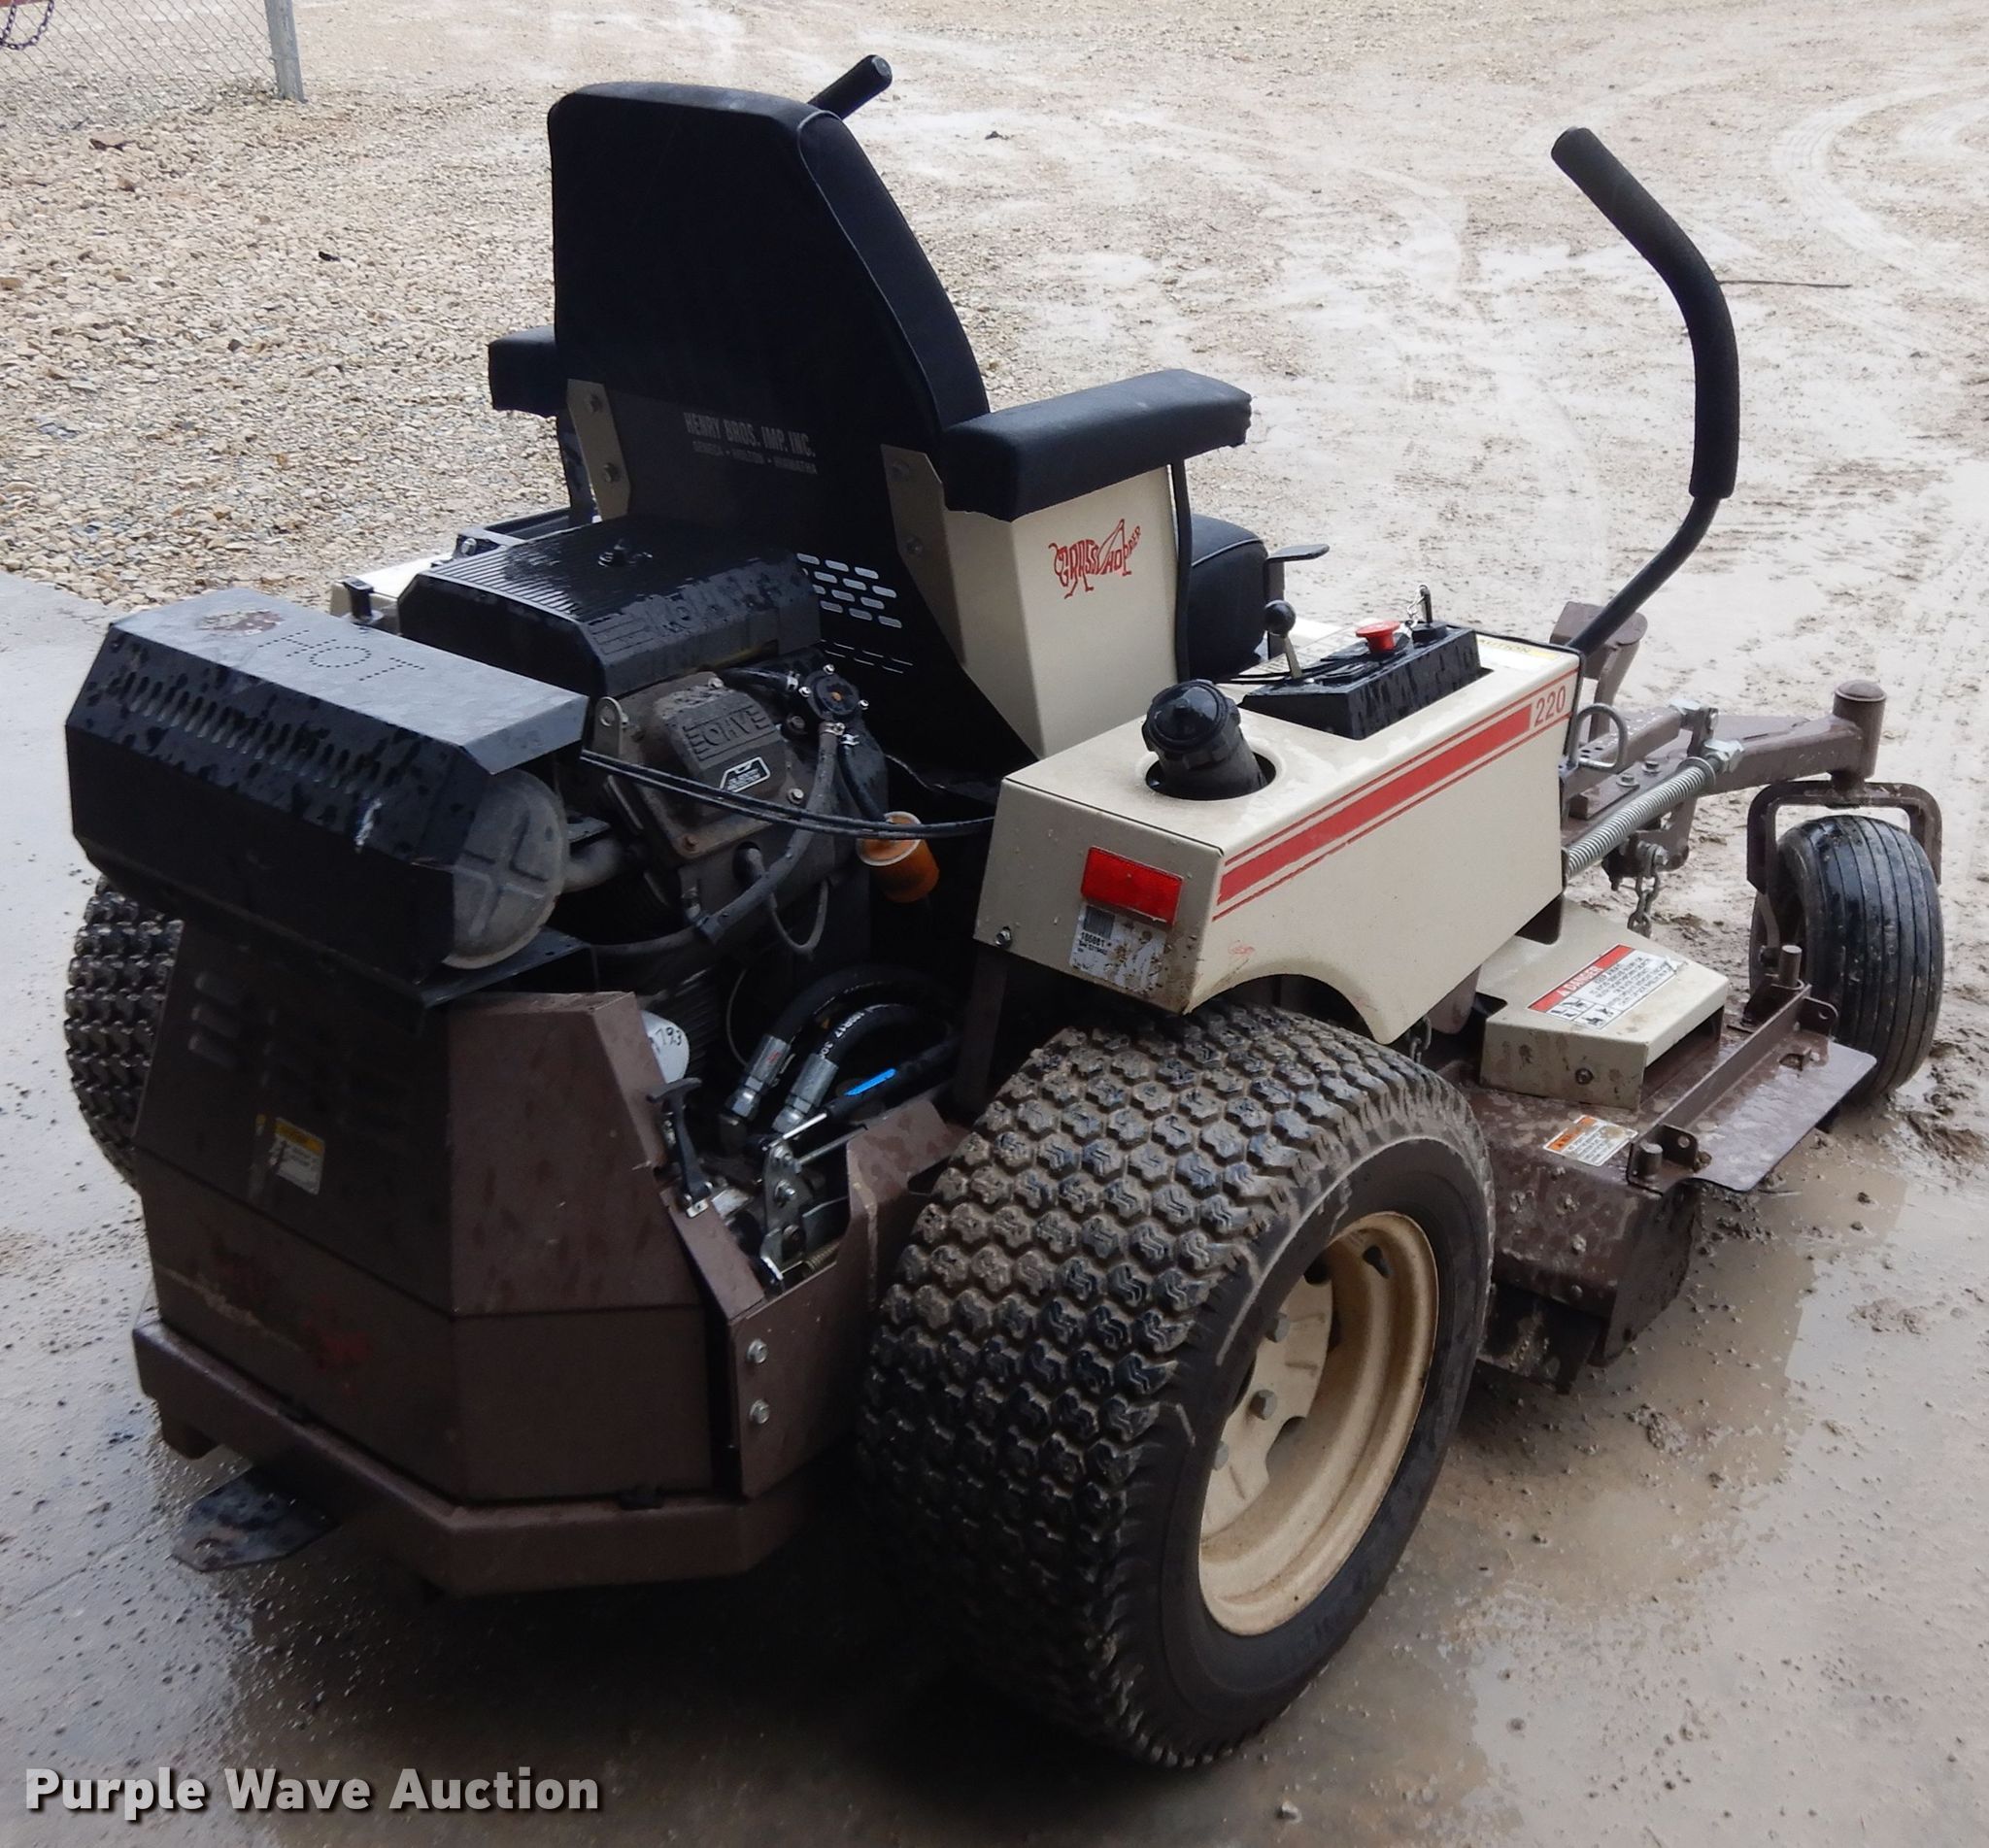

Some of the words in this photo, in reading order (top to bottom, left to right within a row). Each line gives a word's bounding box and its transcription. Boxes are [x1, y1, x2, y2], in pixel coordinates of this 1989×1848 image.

[683, 412, 722, 440] HENRY
[723, 419, 761, 447] BROS.
[761, 425, 789, 452] IMP.
[788, 430, 817, 457] INC.
[1049, 519, 1141, 599] GRASSHOPPER
[258, 629, 425, 681] HOT
[1534, 686, 1567, 727] 220
[1567, 964, 1602, 991] DANGER
